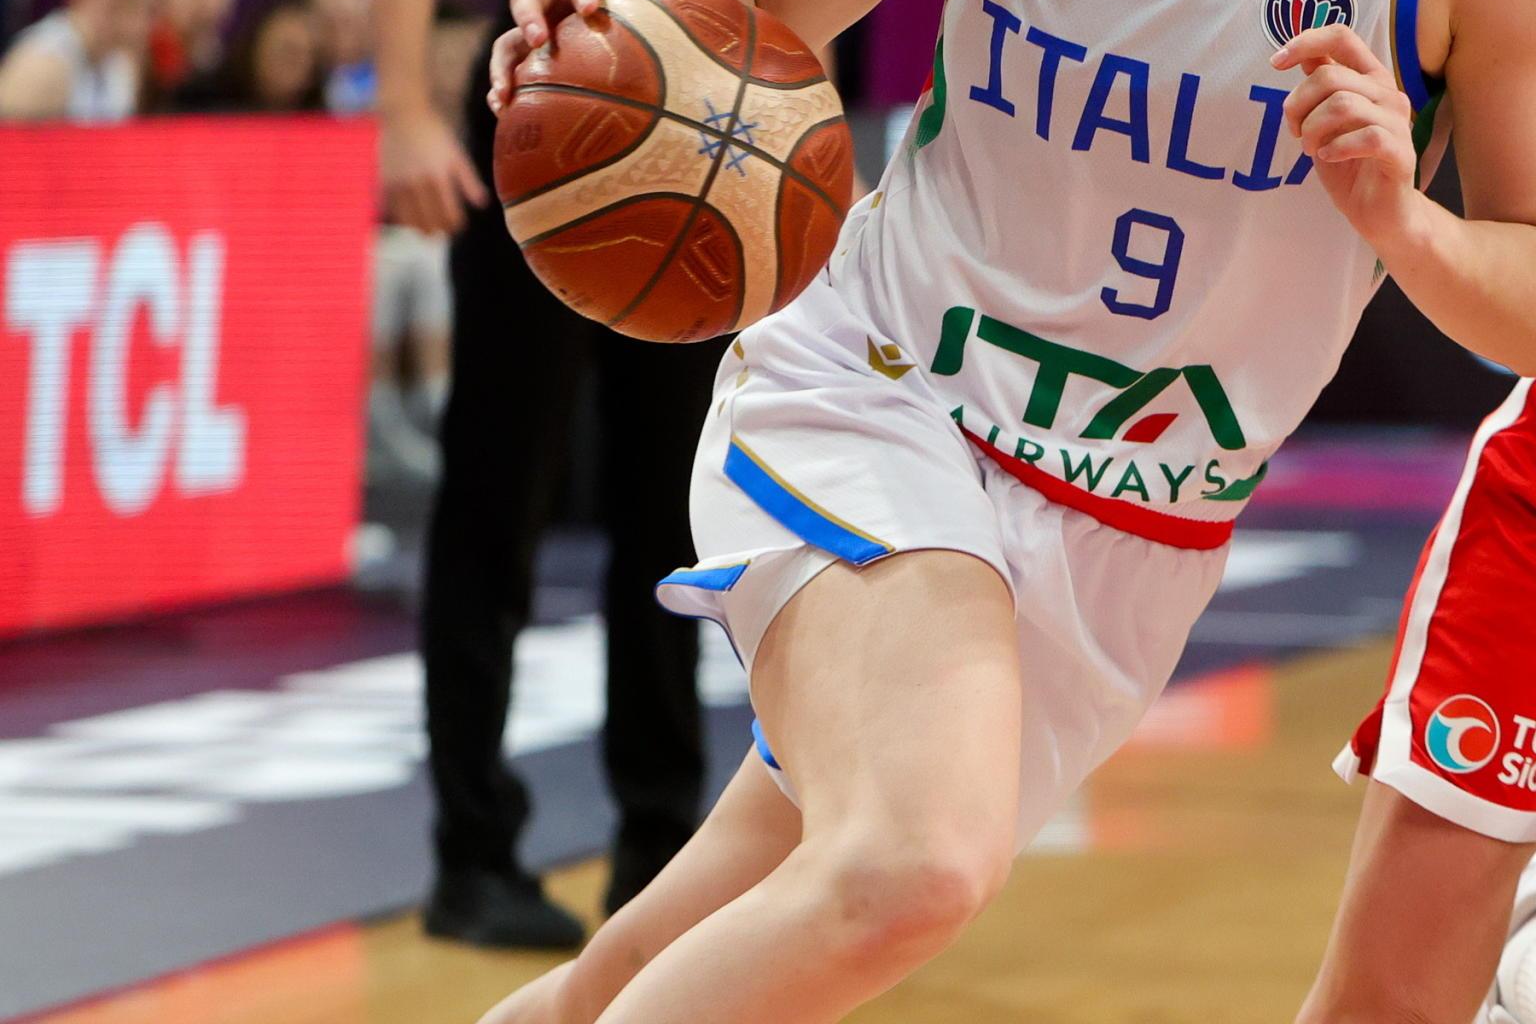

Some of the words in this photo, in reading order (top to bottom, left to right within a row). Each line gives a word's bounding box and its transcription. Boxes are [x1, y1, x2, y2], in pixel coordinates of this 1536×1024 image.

[1100, 207, 1186, 321] 9
[8, 221, 248, 519] TCL
[930, 305, 1247, 451] ITA
